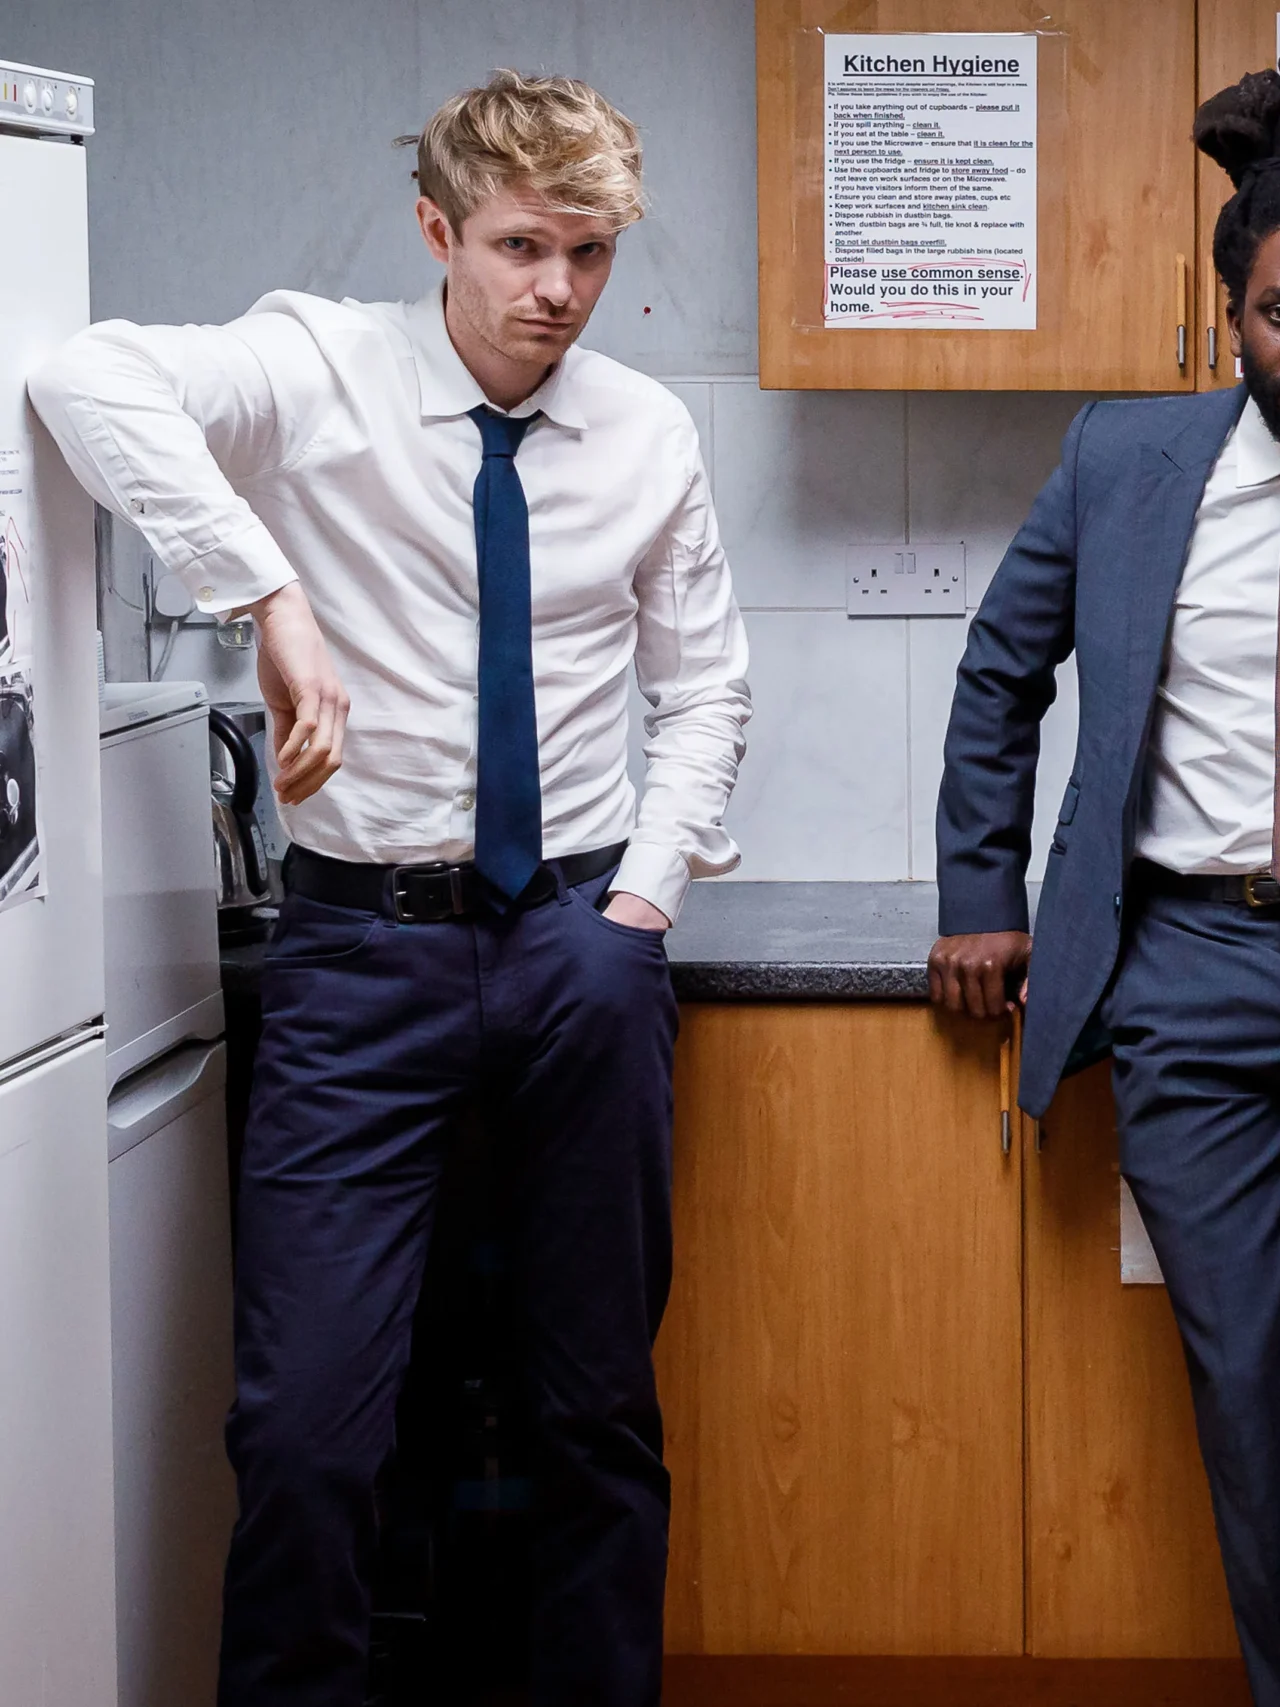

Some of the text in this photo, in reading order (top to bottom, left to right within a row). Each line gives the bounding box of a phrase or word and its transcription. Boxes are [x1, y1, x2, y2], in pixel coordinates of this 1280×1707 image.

[843, 54, 1019, 75] Kitchen Hygiene
[834, 103, 838, 111] If
[841, 103, 854, 111] you
[856, 103, 871, 111] take
[873, 103, 904, 111] anything
[906, 103, 918, 111] out
[920, 103, 927, 111] of
[929, 103, 967, 111] cupboards
[976, 103, 1000, 111] please
[1001, 103, 1013, 111] put
[1015, 103, 1020, 111] it
[834, 121, 838, 129] If
[841, 121, 854, 129] you
[856, 121, 871, 129] spill
[873, 121, 904, 129] anything
[912, 121, 932, 129] clean
[834, 139, 839, 147] If
[841, 139, 854, 147] you
[856, 139, 869, 147] use
[871, 139, 882, 147] the
[884, 139, 923, 147] Microwave
[931, 139, 956, 147] ensure
[958, 139, 972, 147] that
[973, 139, 978, 147] it
[980, 139, 987, 147] is
[988, 139, 1008, 147] clean
[1010, 139, 1020, 147] for
[1021, 139, 1033, 147] the
[834, 184, 993, 192] If you have visitors inform them of the same.
[835, 193, 1011, 201] Ensure you clean and store away plates, cups etc
[835, 238, 946, 246] Do not let dustbin bags overfill.
[835, 247, 1023, 255] Dispose filled bags in the large rubbish bins (located
[830, 266, 1023, 279] Please use common sense.
[831, 283, 1012, 299] Would you do this in your
[831, 301, 873, 313] home.
